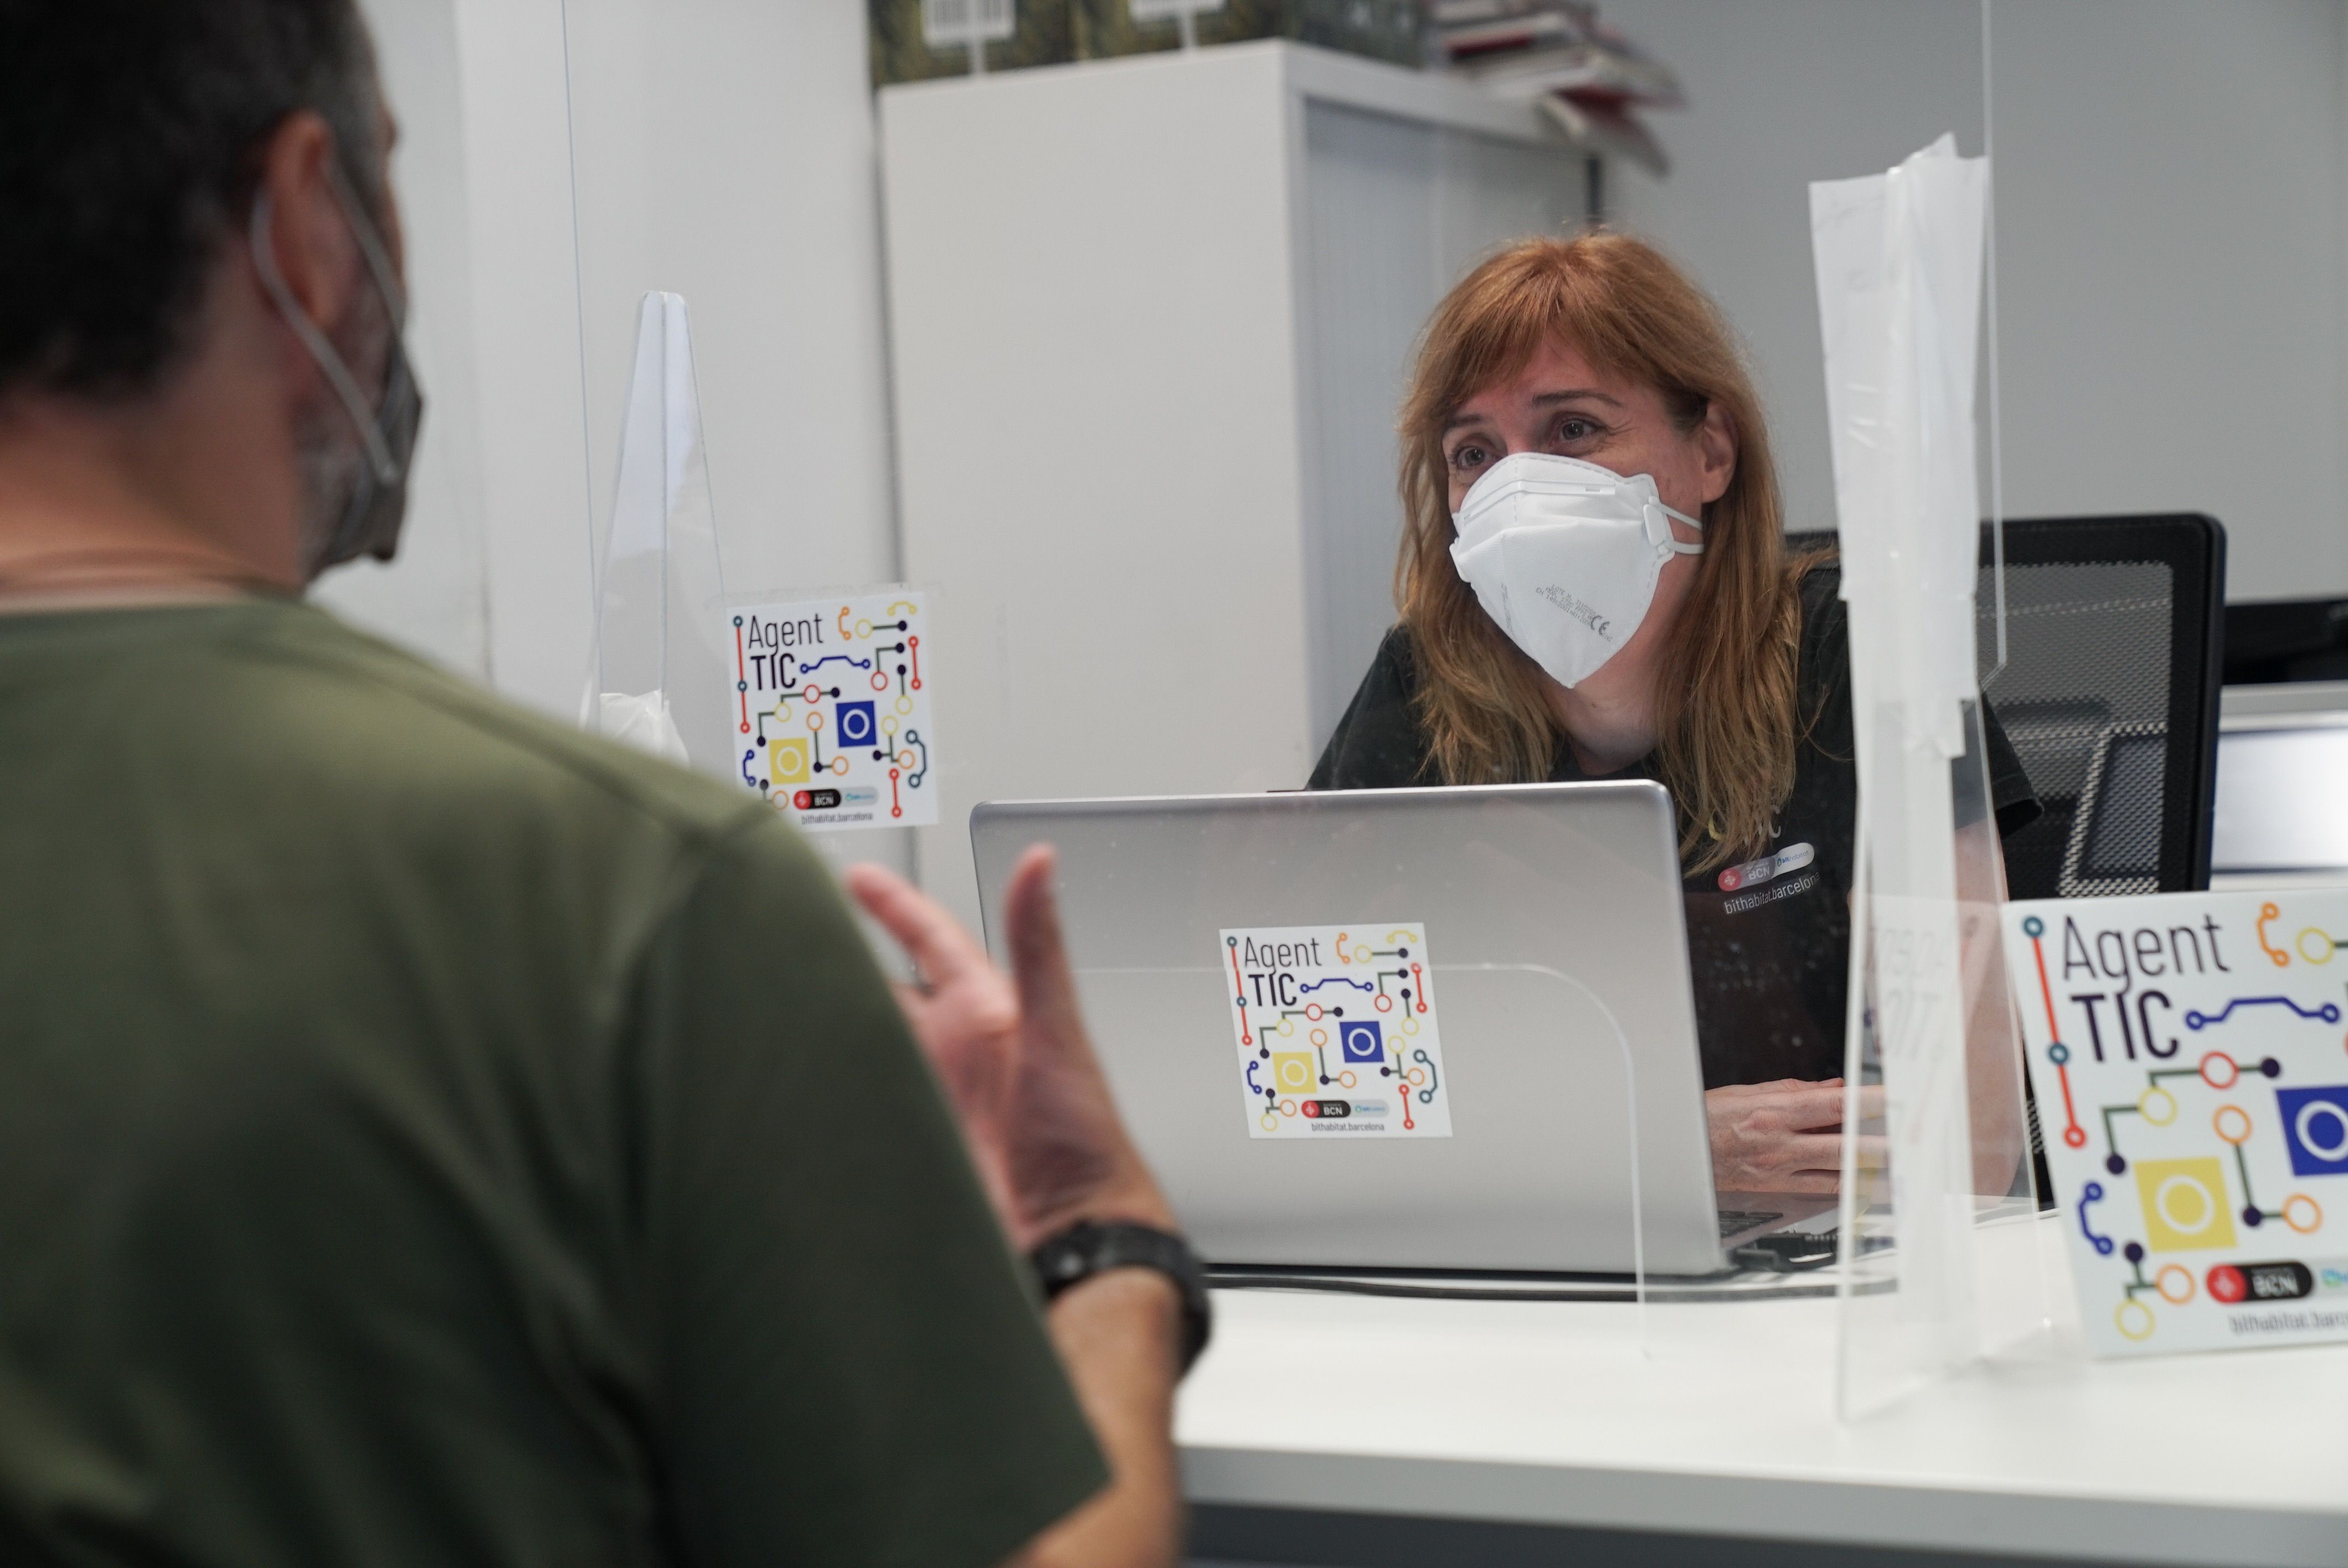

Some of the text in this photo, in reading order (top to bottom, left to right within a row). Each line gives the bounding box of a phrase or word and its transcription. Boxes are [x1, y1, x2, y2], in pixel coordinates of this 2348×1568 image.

[748, 613, 824, 655] Agent
[750, 652, 796, 691] TIC
[1724, 871, 1820, 915] bithabitat.barcelona
[1244, 936, 1322, 974] Agent
[2062, 914, 2231, 994] Agent
[1248, 973, 1297, 1007] TIC
[2070, 989, 2180, 1062] TIC
[1311, 1122, 1384, 1132] bithabitat.barcelona
[1324, 1106, 1343, 1116] BCN
